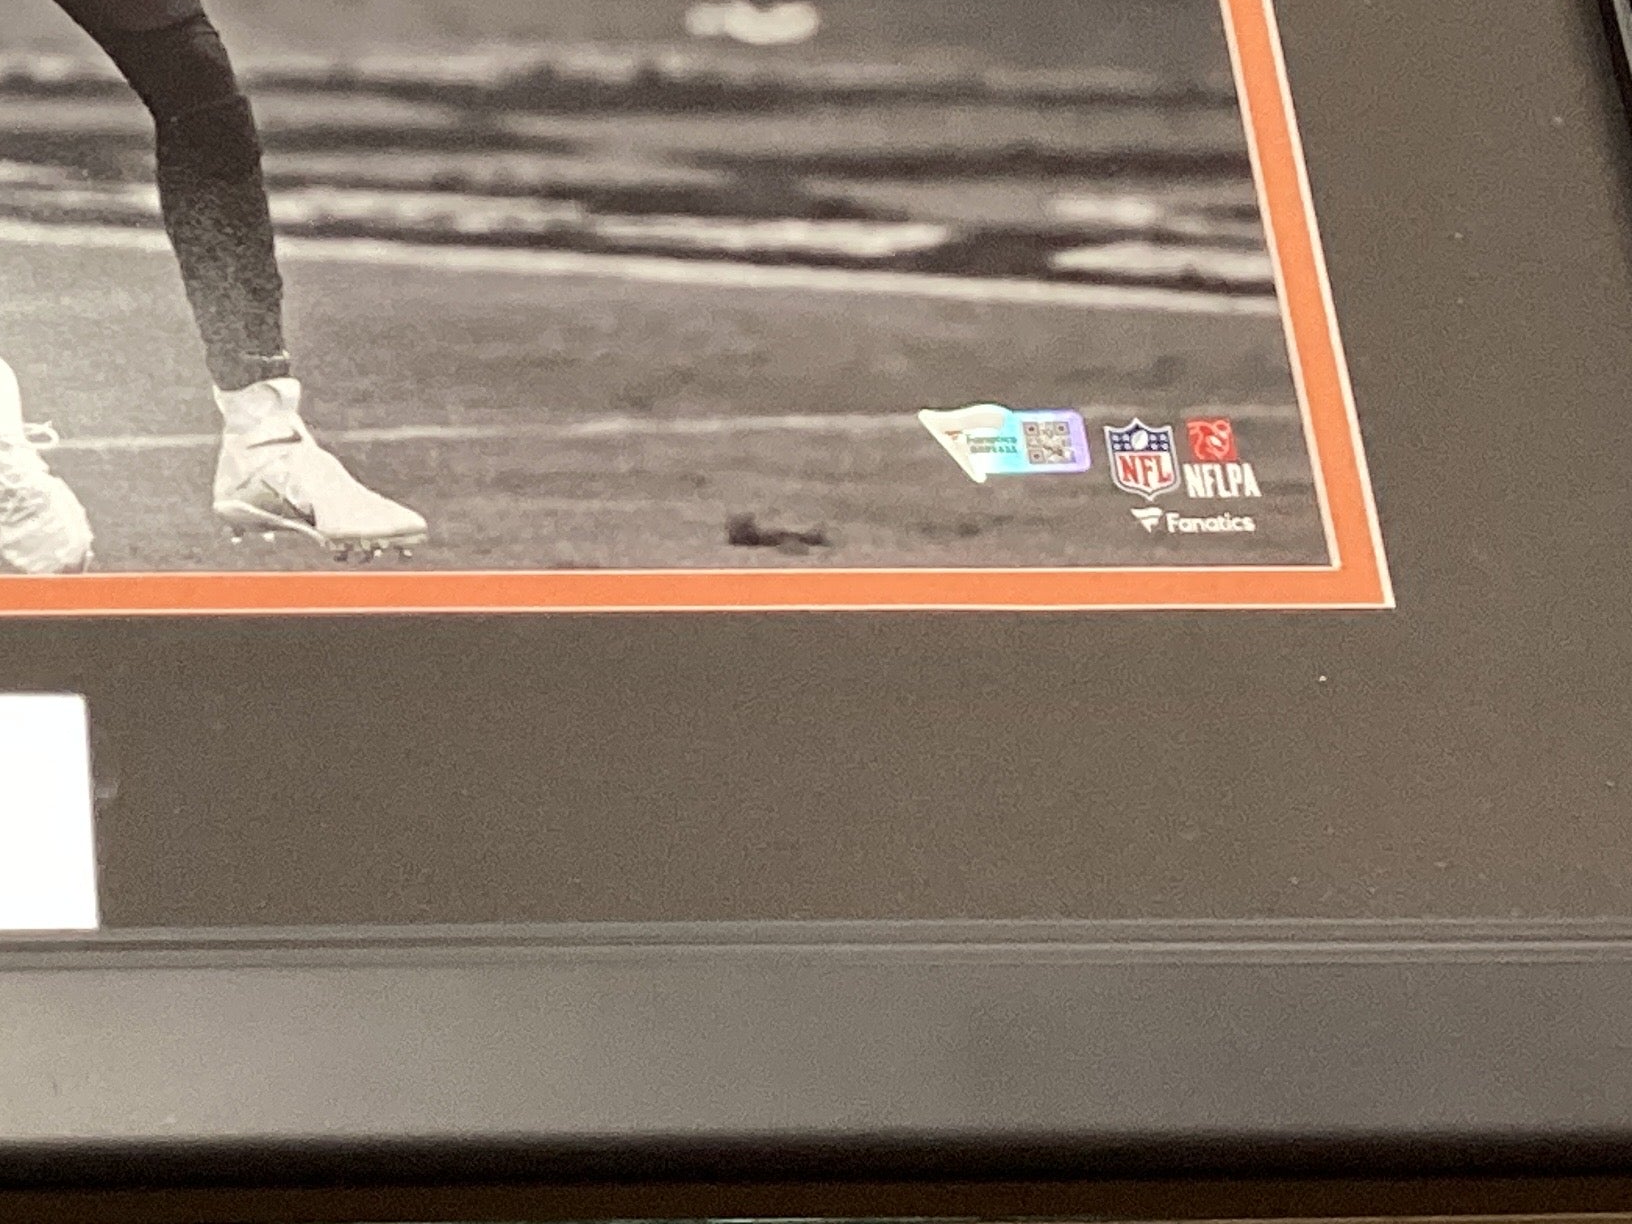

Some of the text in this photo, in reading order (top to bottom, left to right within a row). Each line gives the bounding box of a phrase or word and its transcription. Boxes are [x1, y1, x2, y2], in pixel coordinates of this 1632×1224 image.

[1119, 454, 1171, 487] NFL
[1182, 463, 1261, 498] NFLPA
[1166, 511, 1256, 534] Fanatics
